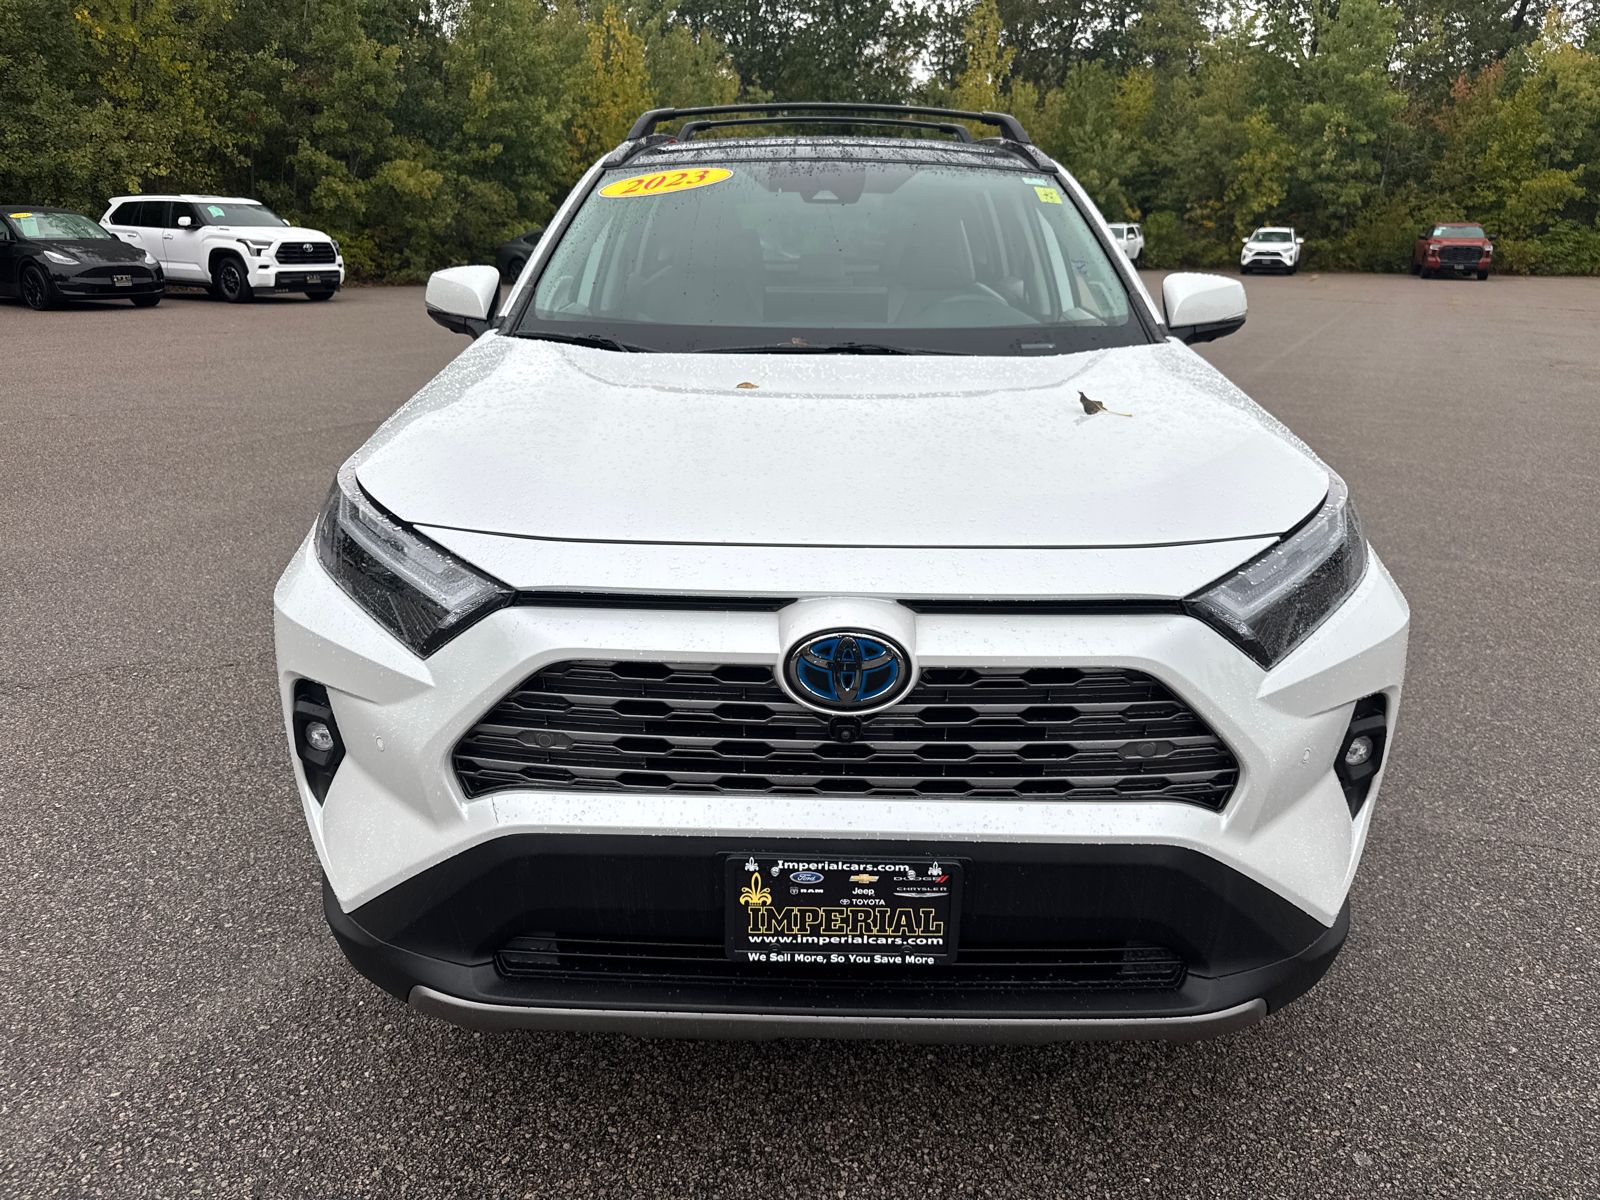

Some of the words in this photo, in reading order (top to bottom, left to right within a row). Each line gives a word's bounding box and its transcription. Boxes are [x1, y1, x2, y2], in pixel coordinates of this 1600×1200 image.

[620, 170, 710, 194] 2023
[777, 860, 910, 872] Imperialcars.com
[852, 887, 874, 896] Jeep
[748, 906, 944, 936] IMPERIAL
[748, 935, 943, 946] www.imperialcars.com
[748, 953, 767, 962] We
[769, 953, 791, 962] Sell
[794, 954, 827, 964] More,
[830, 955, 845, 963] So
[848, 955, 871, 964] You
[873, 955, 902, 964] Save
[905, 956, 935, 965] More
